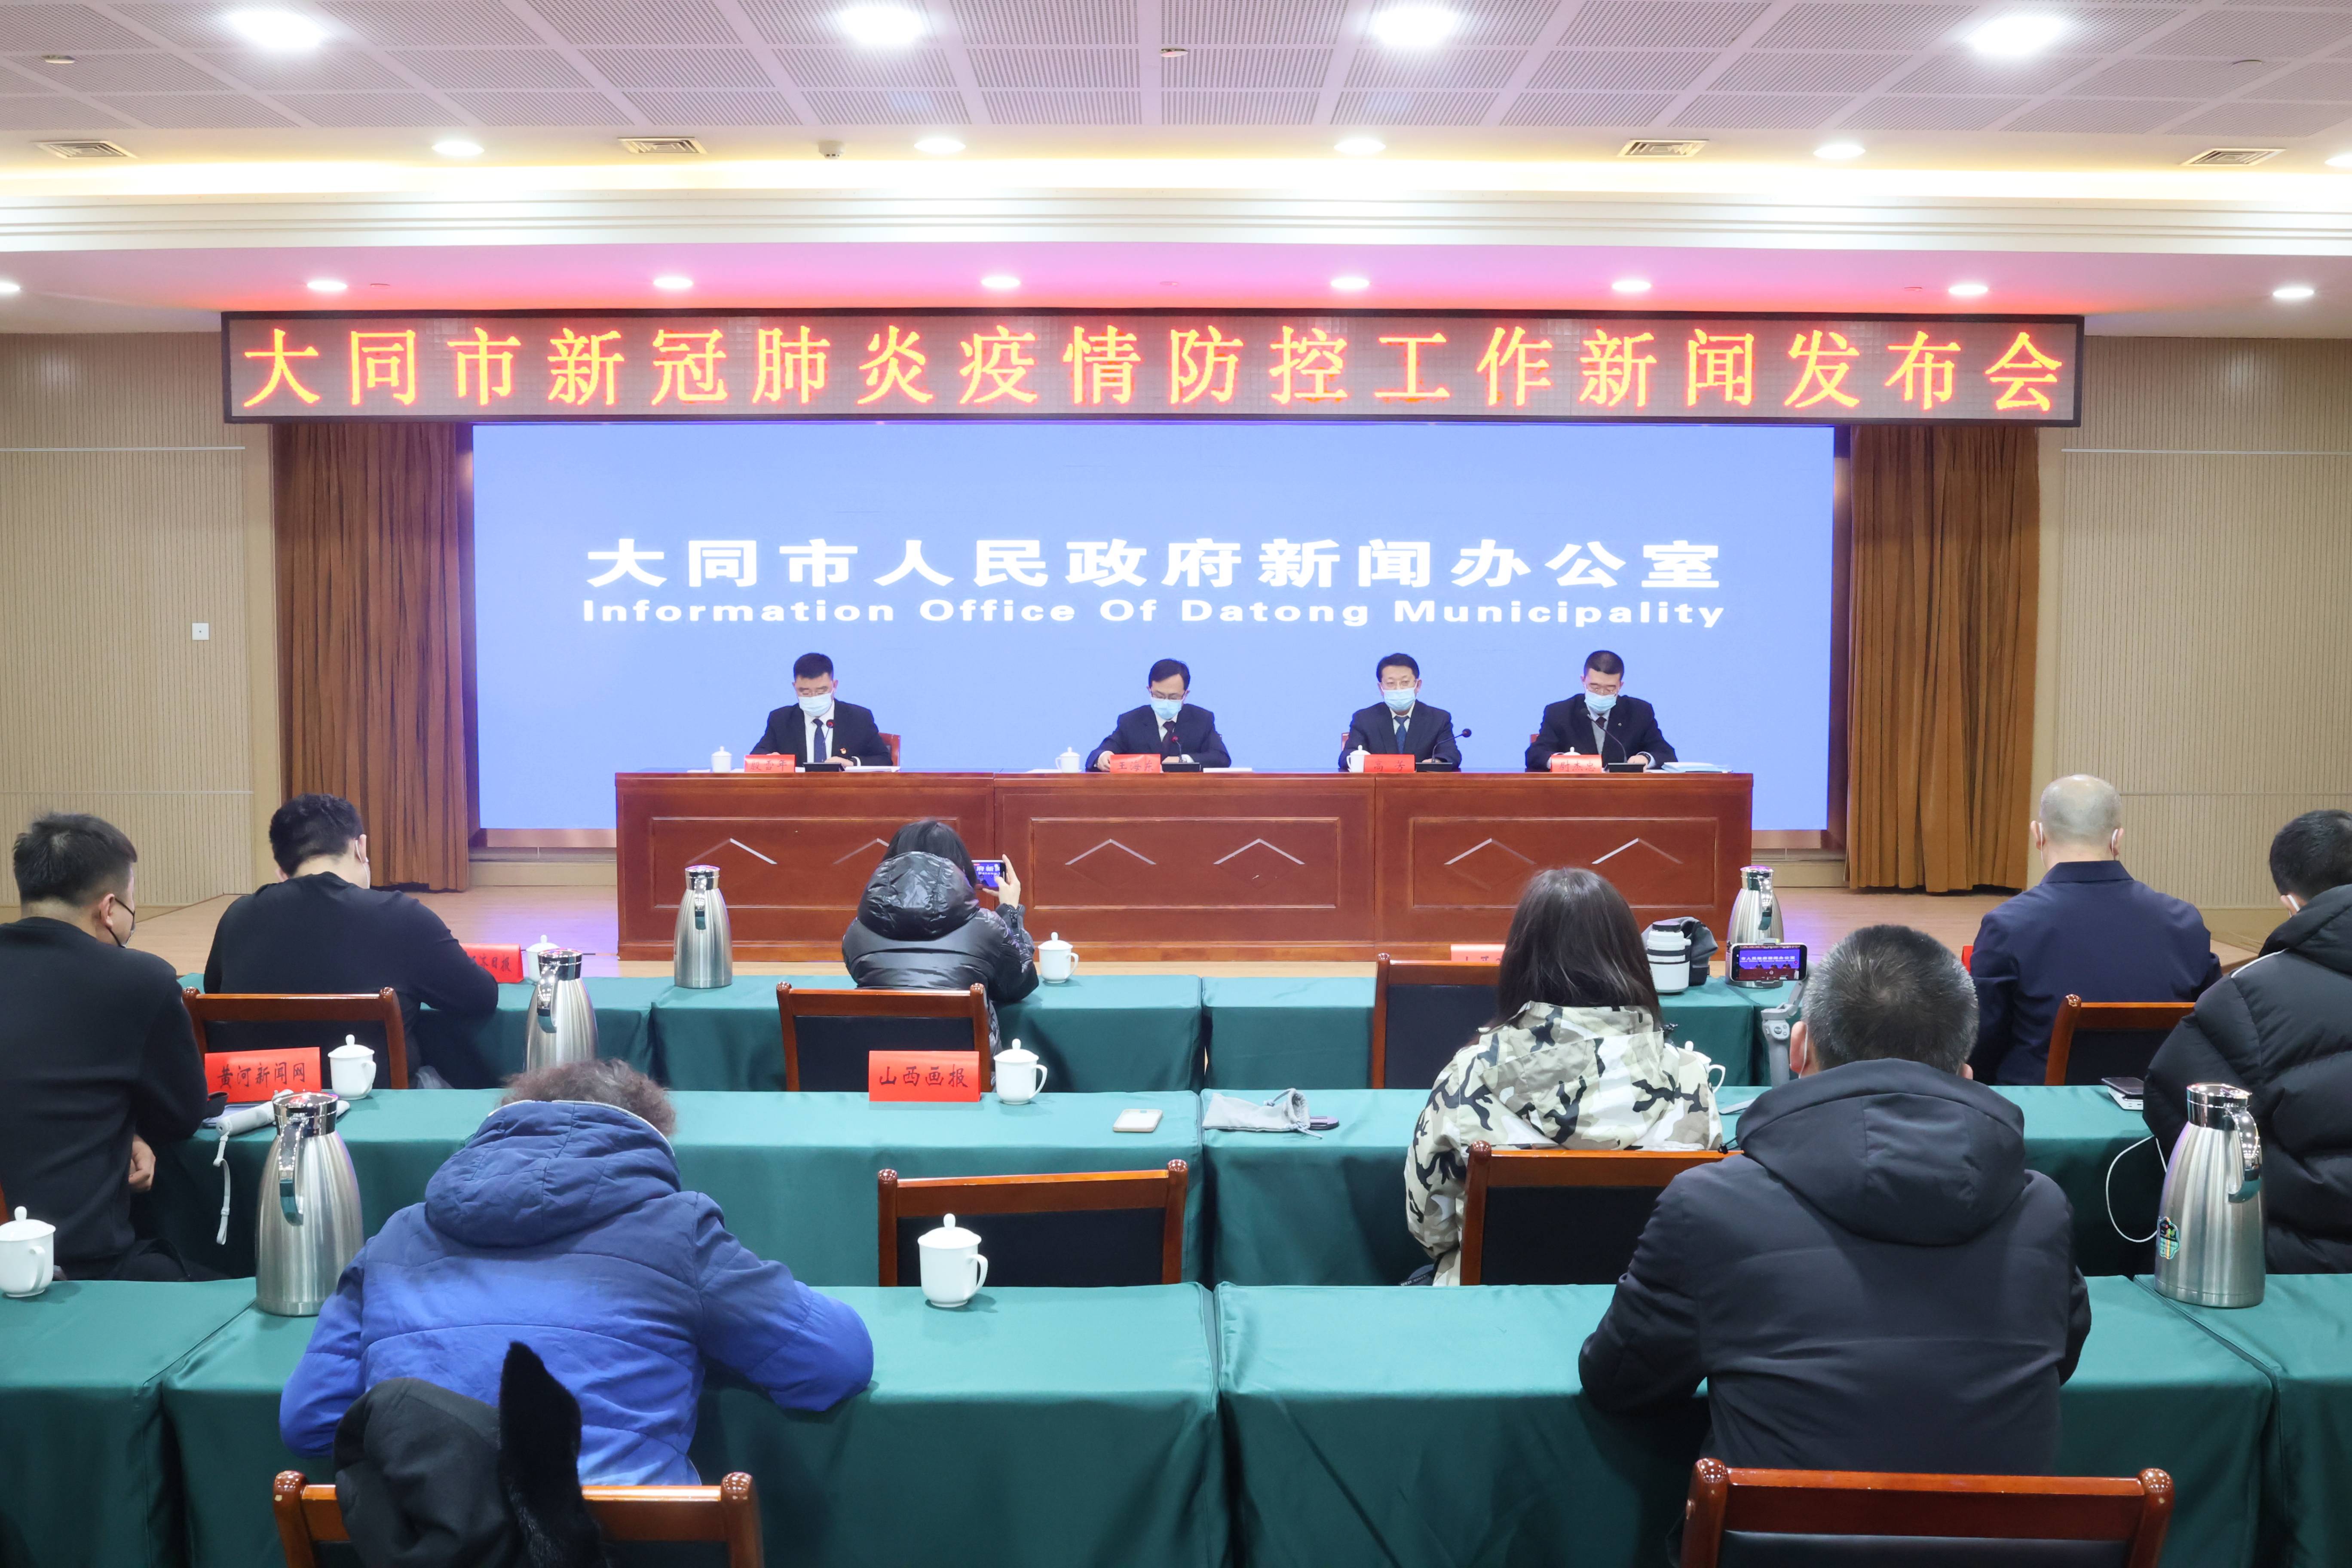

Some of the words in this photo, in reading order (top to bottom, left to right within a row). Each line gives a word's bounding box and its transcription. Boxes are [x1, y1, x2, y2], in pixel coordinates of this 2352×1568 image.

[243, 325, 2063, 411] 大同市新冠肺炎疫情防控工作新闻发布会
[586, 538, 1720, 588] 大同市人民政府新闻办公室
[583, 599, 894, 622] Information
[919, 599, 1075, 622] Office
[1099, 599, 1157, 622] Of
[1182, 599, 1368, 627] Datong
[1394, 600, 1724, 628] Municipality
[217, 1062, 306, 1089] 黄河新闻网
[879, 1064, 968, 1087] 山西画报
